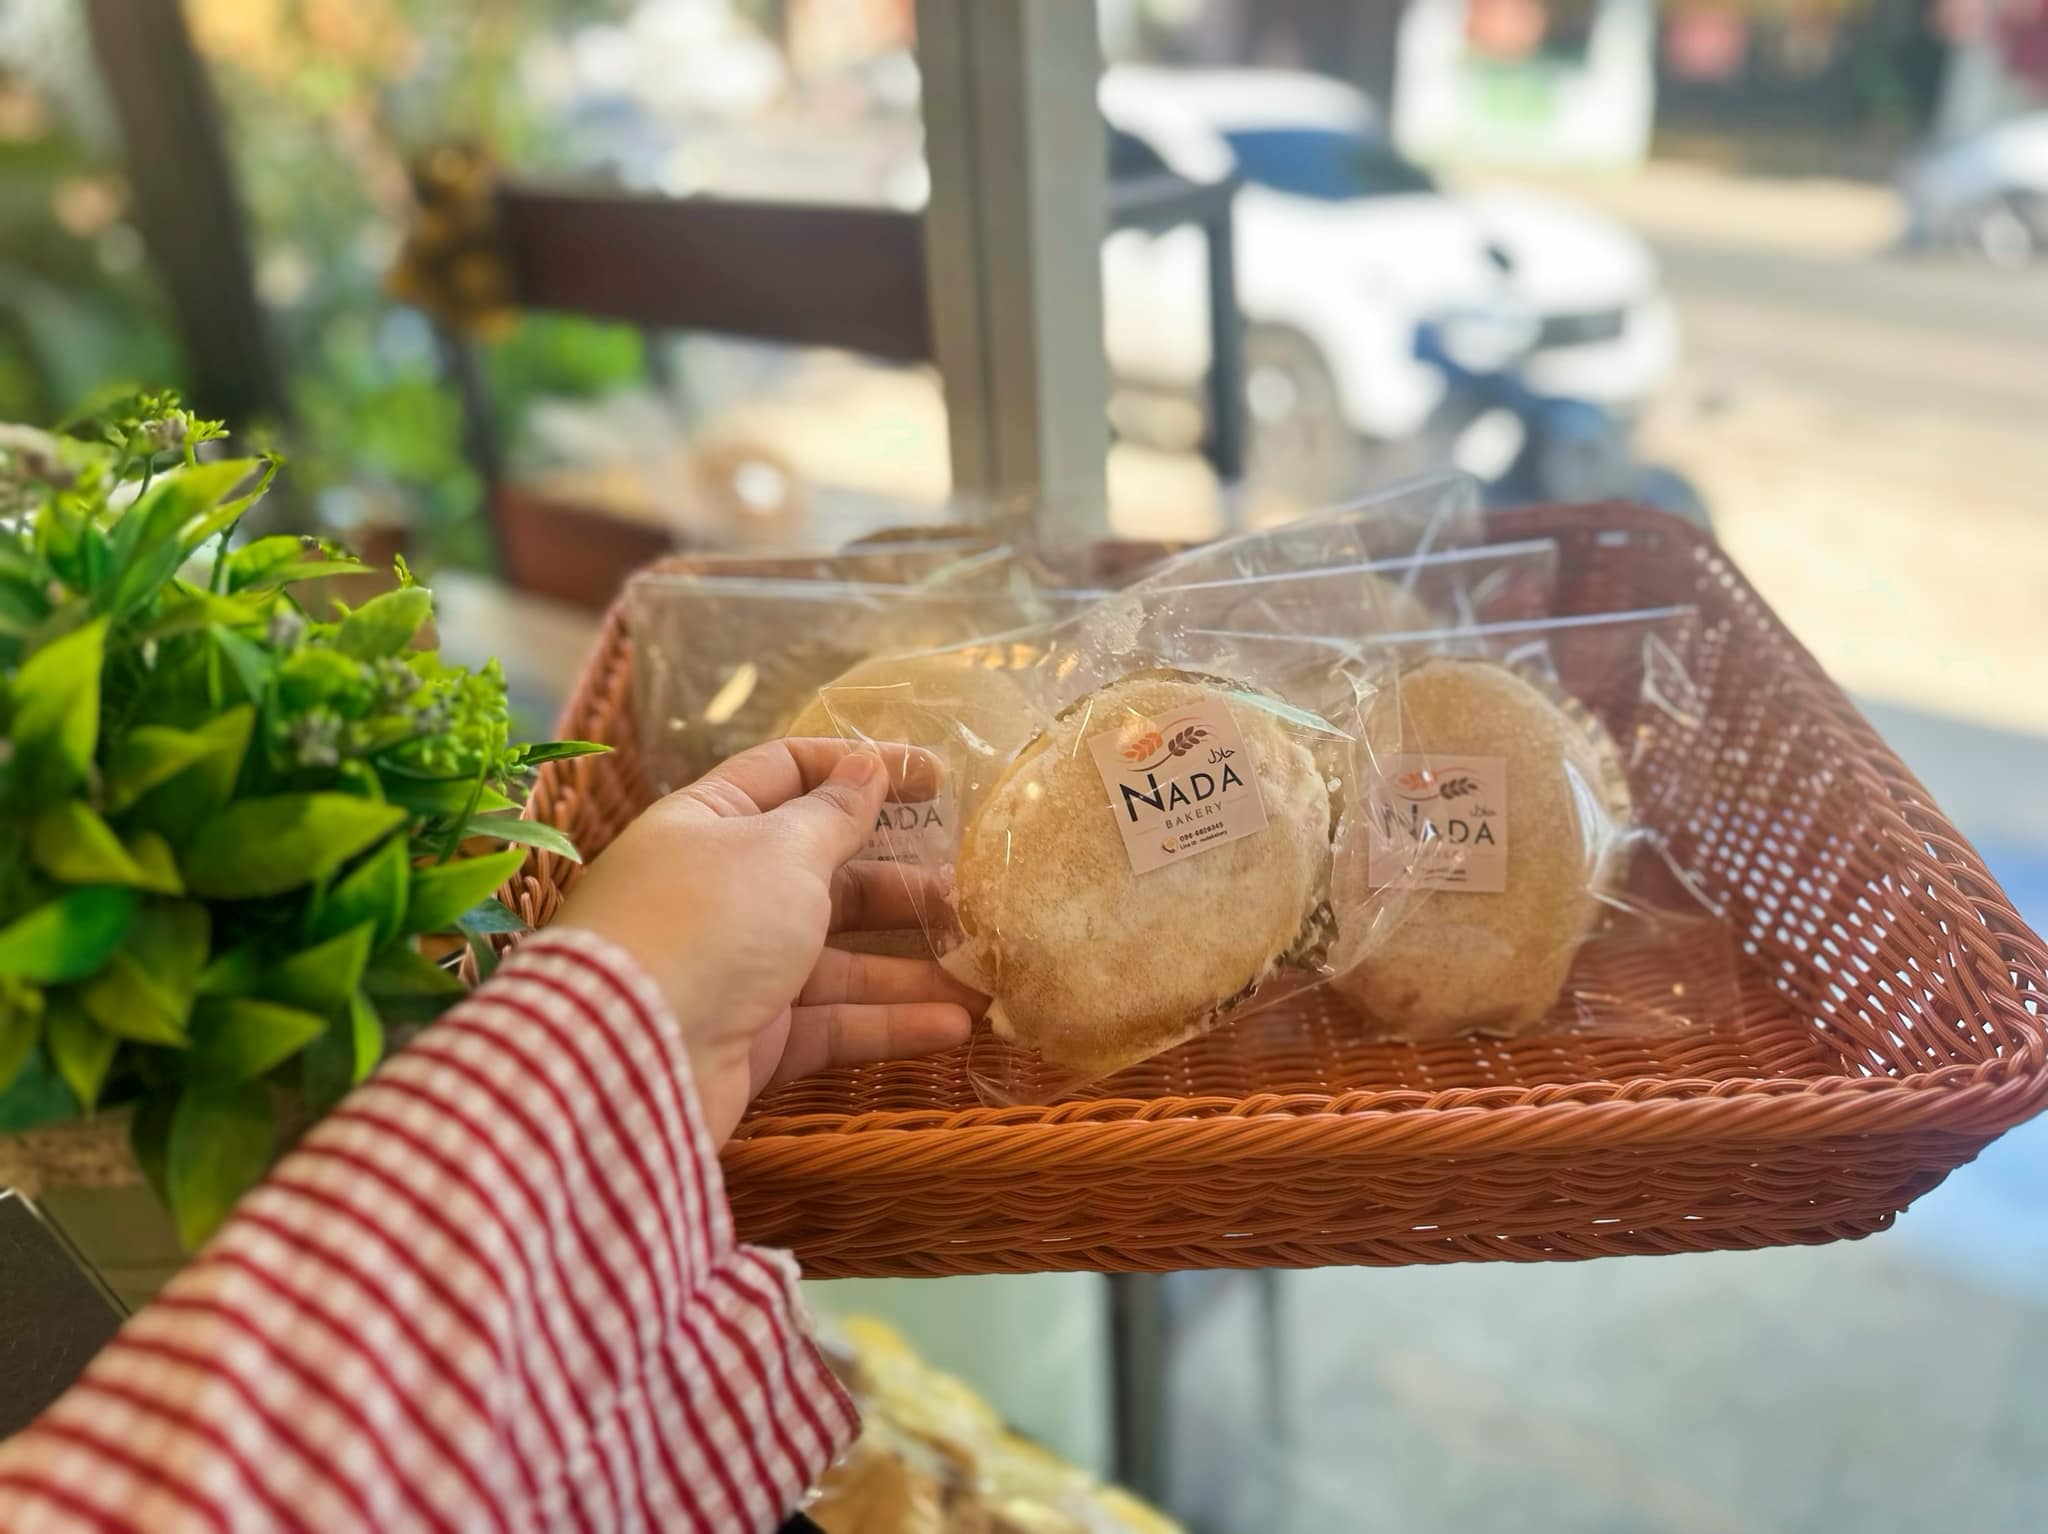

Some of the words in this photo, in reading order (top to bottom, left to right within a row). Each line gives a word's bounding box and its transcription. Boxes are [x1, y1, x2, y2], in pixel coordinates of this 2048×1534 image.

[1207, 746, 1236, 764] حلال
[1119, 763, 1244, 822] NADA
[874, 805, 943, 832] ADA
[1165, 801, 1222, 829] BAKERY
